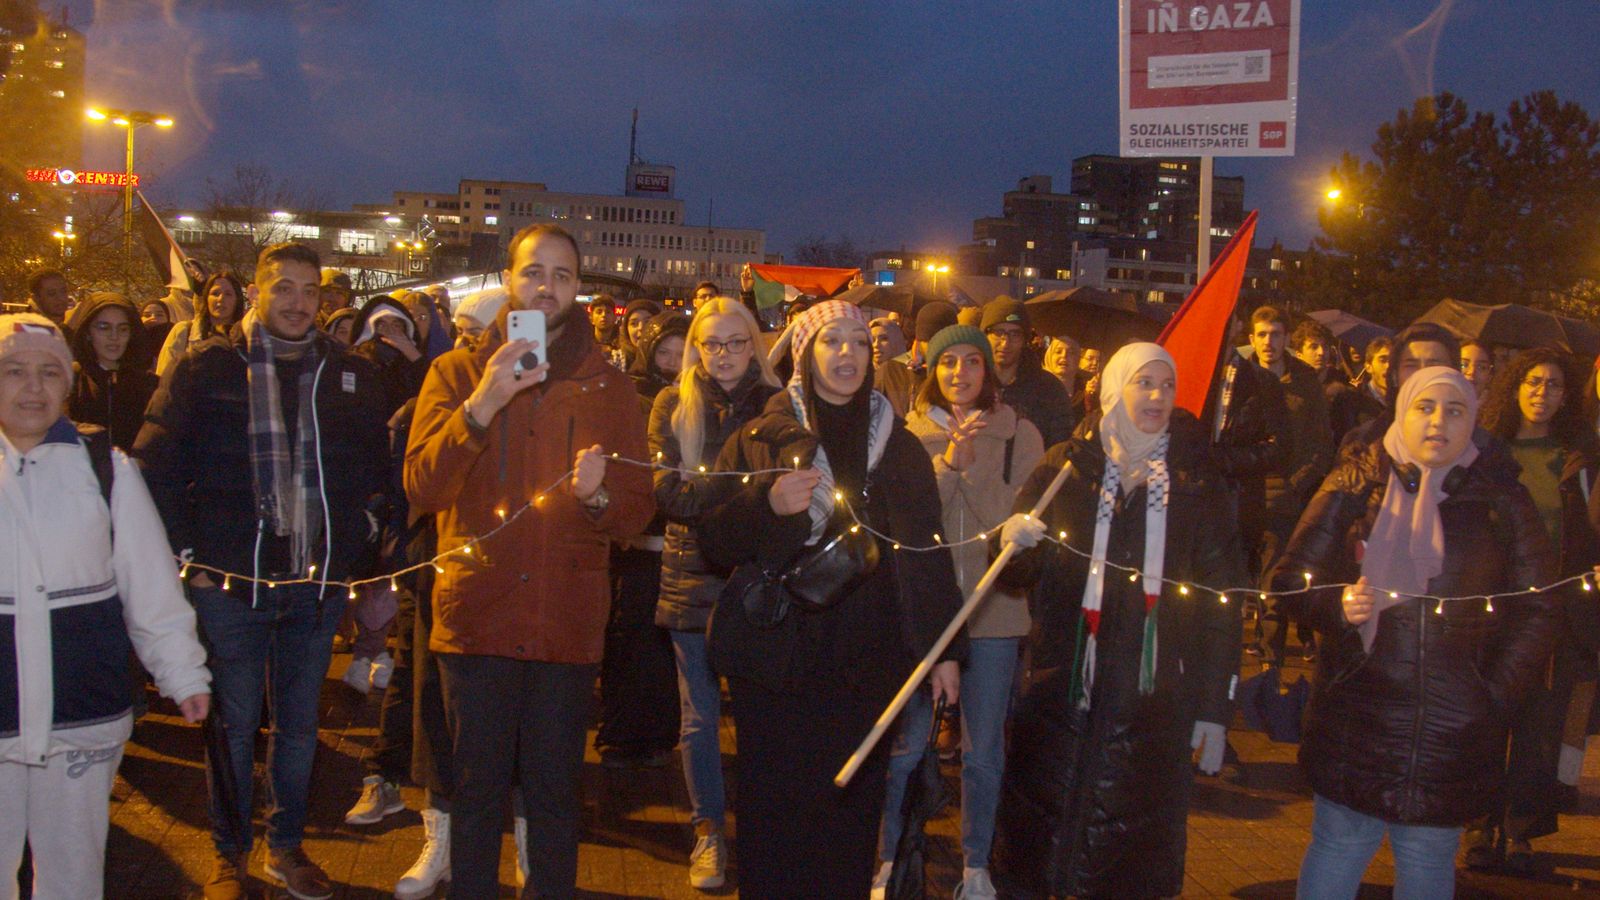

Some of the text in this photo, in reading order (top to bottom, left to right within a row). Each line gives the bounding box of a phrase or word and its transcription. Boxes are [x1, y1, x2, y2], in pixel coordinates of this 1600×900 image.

[1189, 1, 1275, 32] GAZA
[1129, 123, 1249, 136] SOZIALISTISCHE
[1129, 138, 1249, 149] GLEICHHEITSPARTEI
[74, 170, 139, 188] CENTER
[637, 175, 668, 187] REWE
